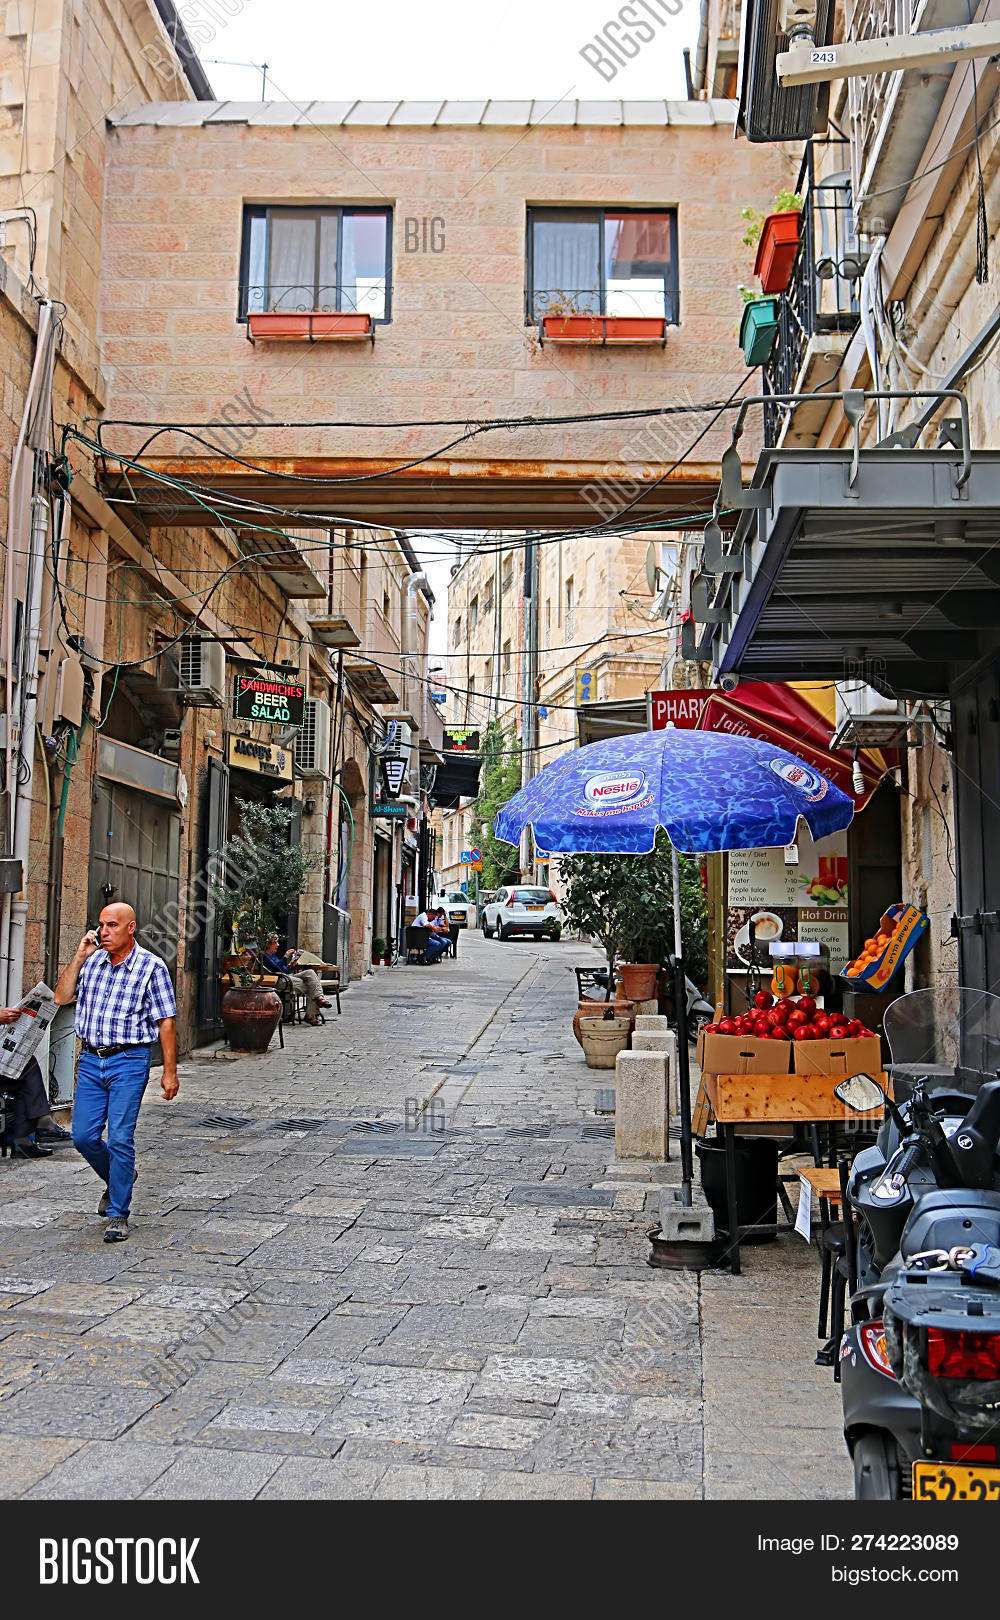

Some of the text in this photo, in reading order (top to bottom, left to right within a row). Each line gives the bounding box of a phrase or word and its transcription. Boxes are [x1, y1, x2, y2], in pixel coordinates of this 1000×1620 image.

[812, 53, 834, 62] 243
[240, 678, 303, 698] SANDWICHES
[254, 692, 288, 708] BEER
[251, 704, 290, 721] SALAD
[713, 711, 752, 737] Jaffa
[233, 738, 272, 761] JACOB'S
[593, 781, 639, 797] Nestlé
[576, 794, 655, 817] Makes me happy!
[801, 910, 848, 920] Hot Drin
